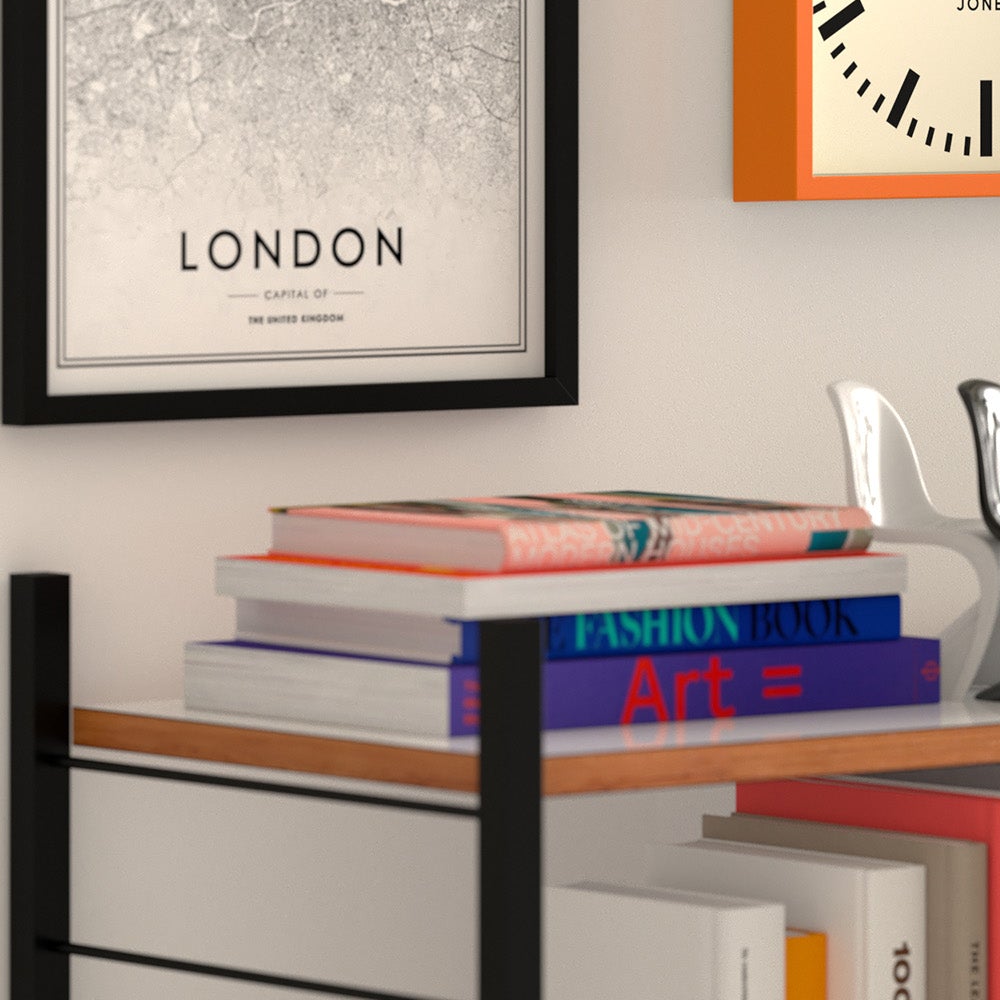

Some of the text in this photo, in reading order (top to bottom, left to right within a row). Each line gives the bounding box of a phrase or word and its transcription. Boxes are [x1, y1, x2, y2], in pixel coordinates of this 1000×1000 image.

[180, 226, 403, 271] LONDON
[263, 288, 328, 300] CAPITAL OF
[248, 313, 344, 325] THE UNITED KINGDOM
[574, 604, 740, 650] FASHION
[751, 599, 859, 641] BOOK
[619, 654, 736, 726] Art
